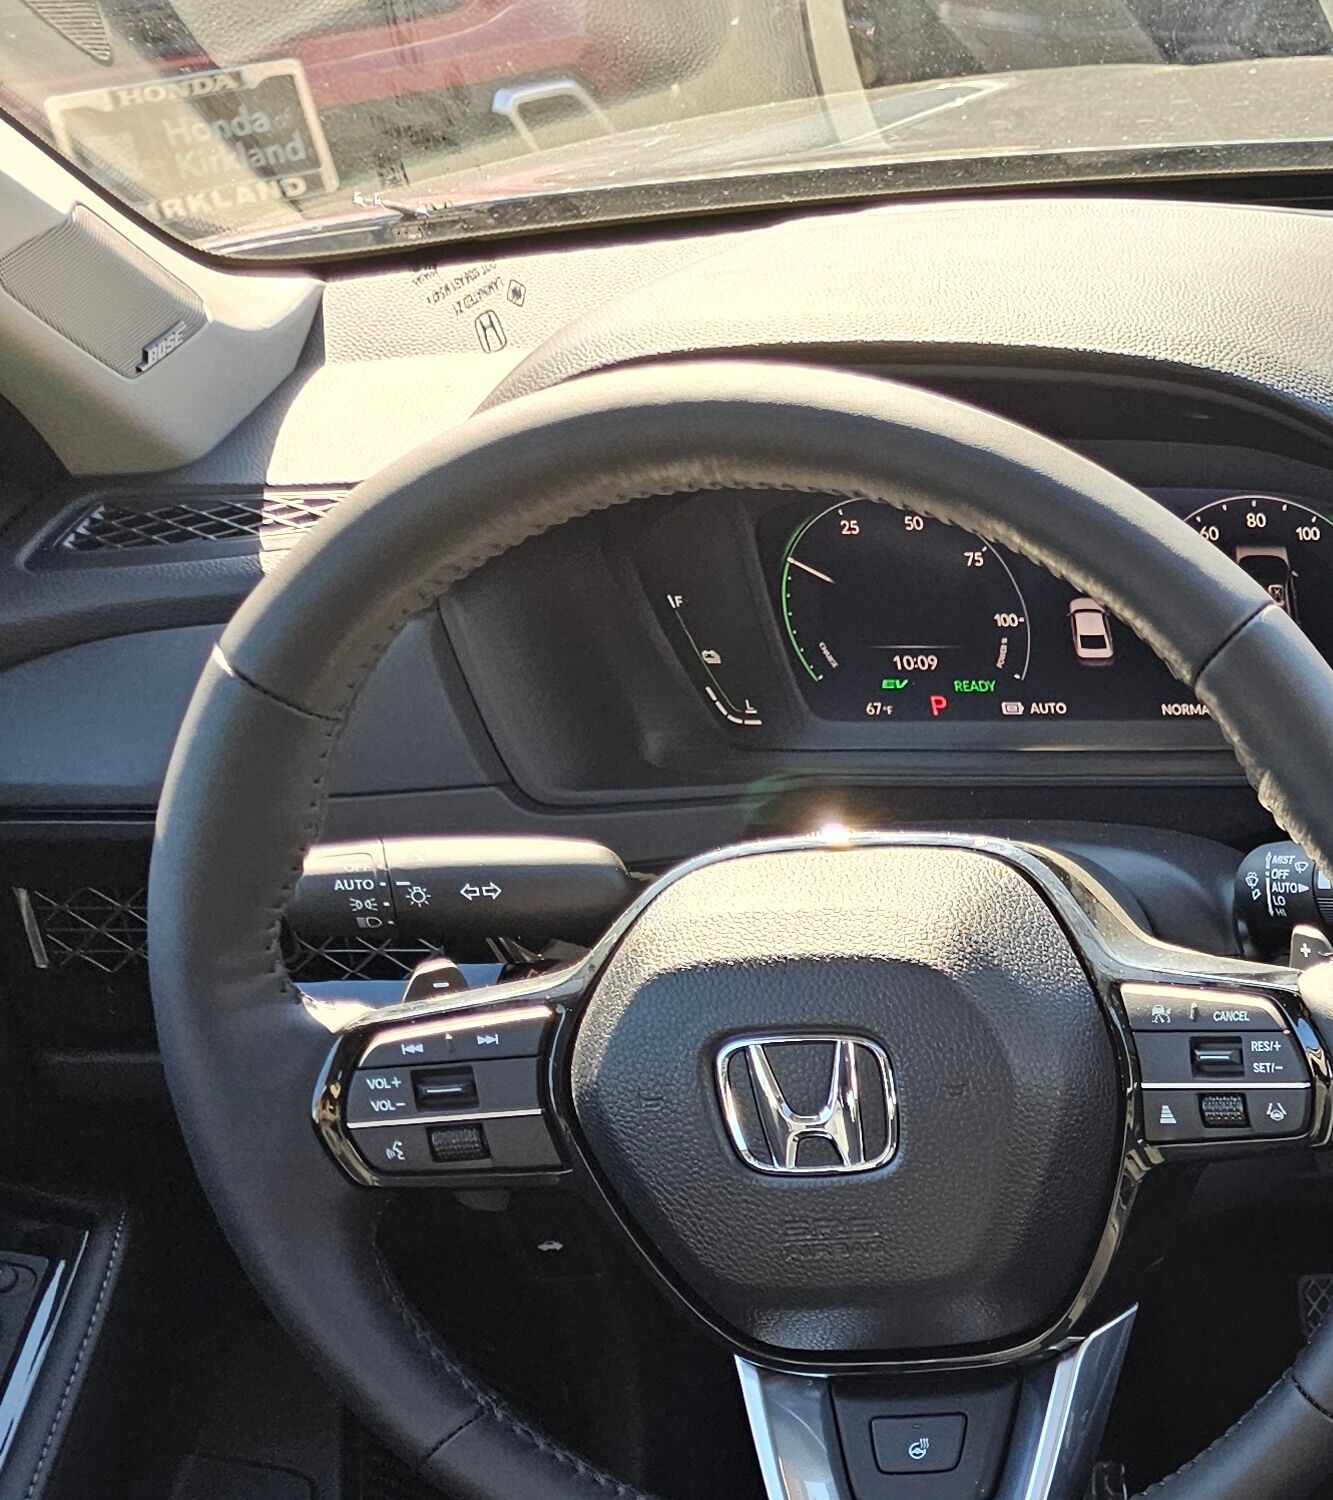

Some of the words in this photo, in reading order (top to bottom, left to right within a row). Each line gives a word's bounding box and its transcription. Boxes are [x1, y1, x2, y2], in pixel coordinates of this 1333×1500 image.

[116, 75, 238, 107] HONDA
[162, 109, 271, 145] Honda
[147, 322, 188, 364] BOSE
[904, 516, 924, 531] 50
[1246, 513, 1267, 528] 80
[840, 520, 859, 535] 25
[1296, 527, 1320, 541] 100
[964, 552, 984, 567] 75
[994, 614, 1018, 627] 100
[893, 655, 938, 671] 10:09
[882, 679, 908, 689] EV
[954, 680, 995, 693] READY
[930, 696, 947, 716] P
[1030, 702, 1066, 715] AUTO
[1272, 855, 1296, 864] MIST
[1271, 869, 1289, 879] OFF
[334, 880, 374, 891] AUTO
[1271, 882, 1298, 894] AUTO
[1272, 896, 1286, 907] LO
[1274, 908, 1288, 917] HI
[1213, 1011, 1250, 1022] CANCEL
[1251, 1040, 1282, 1052] RES/+
[367, 1077, 402, 1089] VOL+
